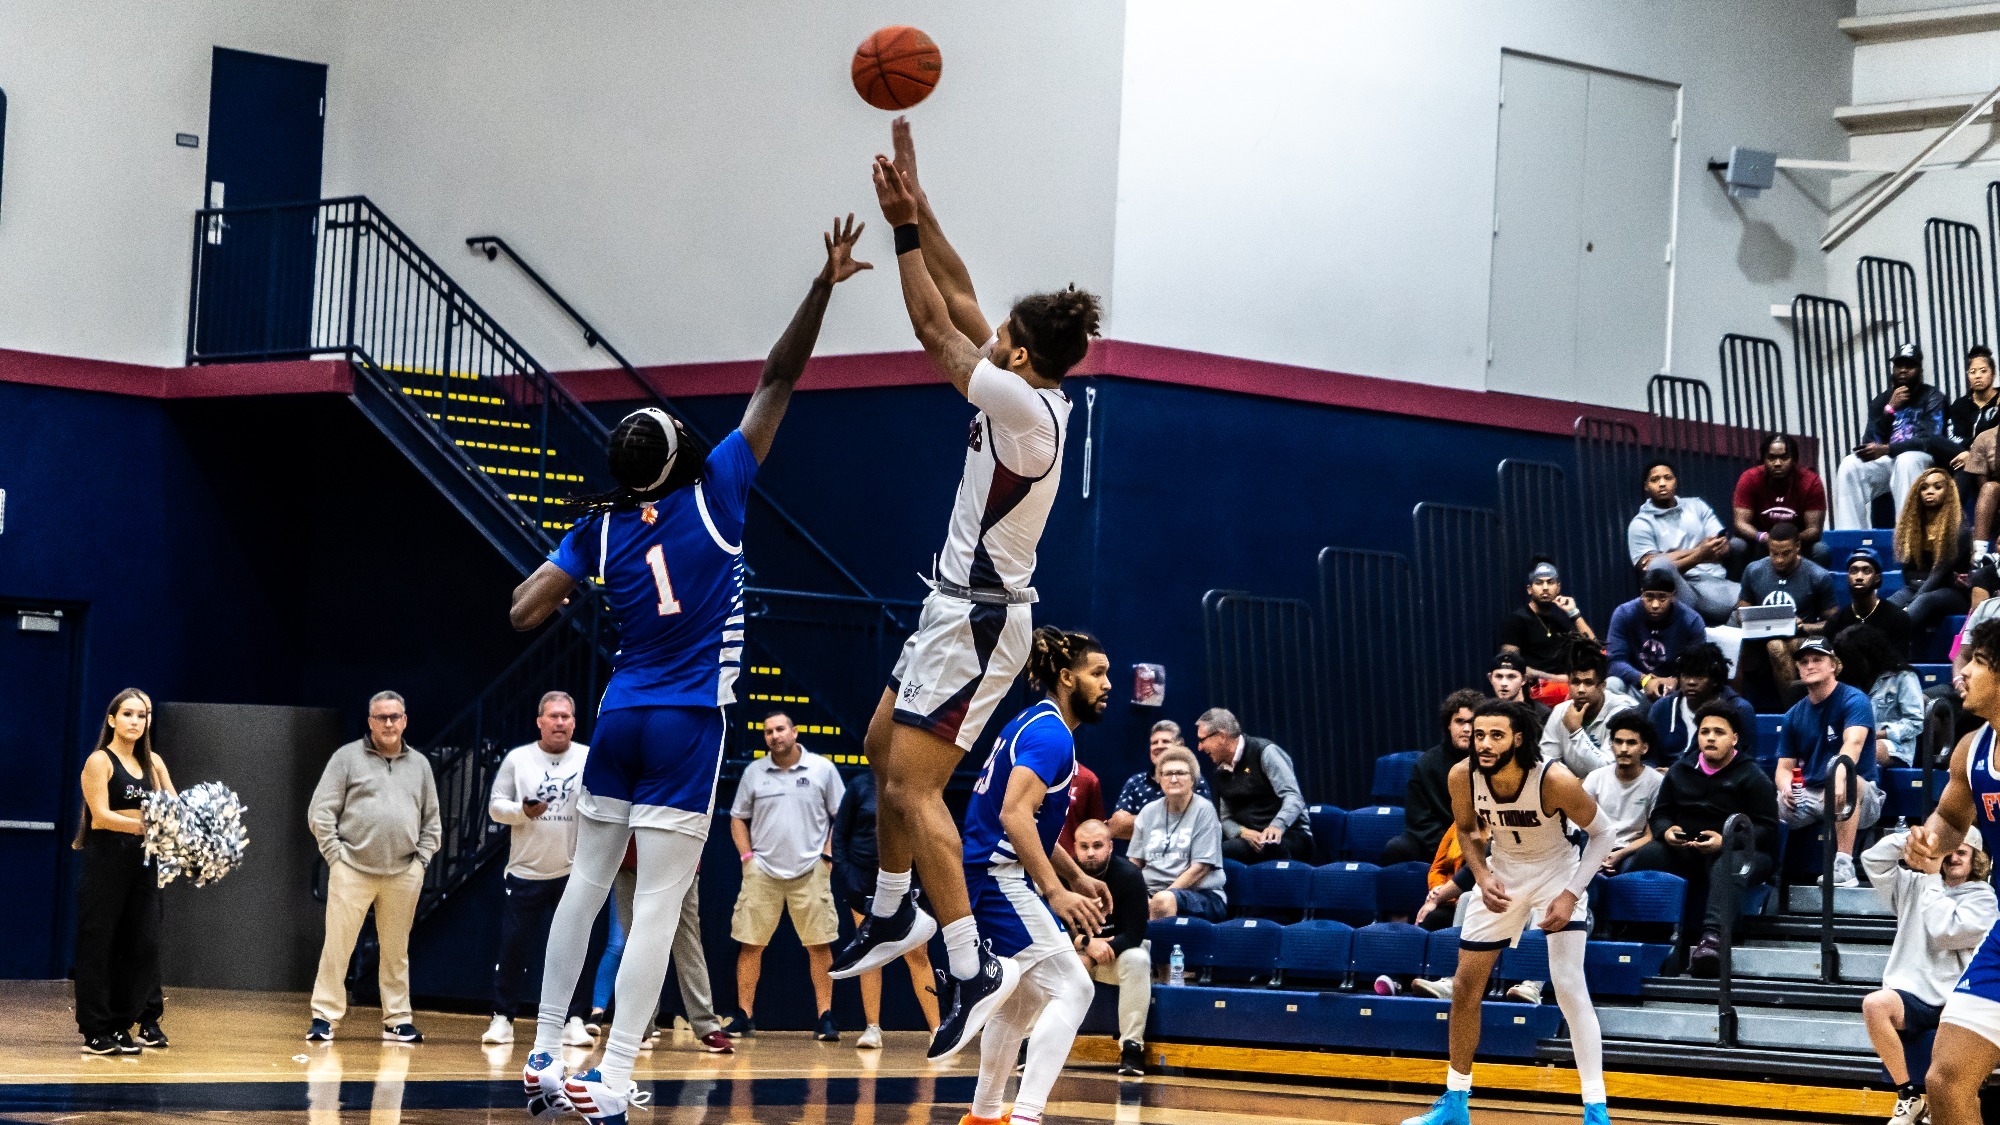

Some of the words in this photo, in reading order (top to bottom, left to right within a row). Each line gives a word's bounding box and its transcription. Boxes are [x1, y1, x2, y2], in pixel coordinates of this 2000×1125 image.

[645, 543, 682, 616] 1
[1981, 792, 2000, 822] F
[1512, 830, 1521, 844] 1
